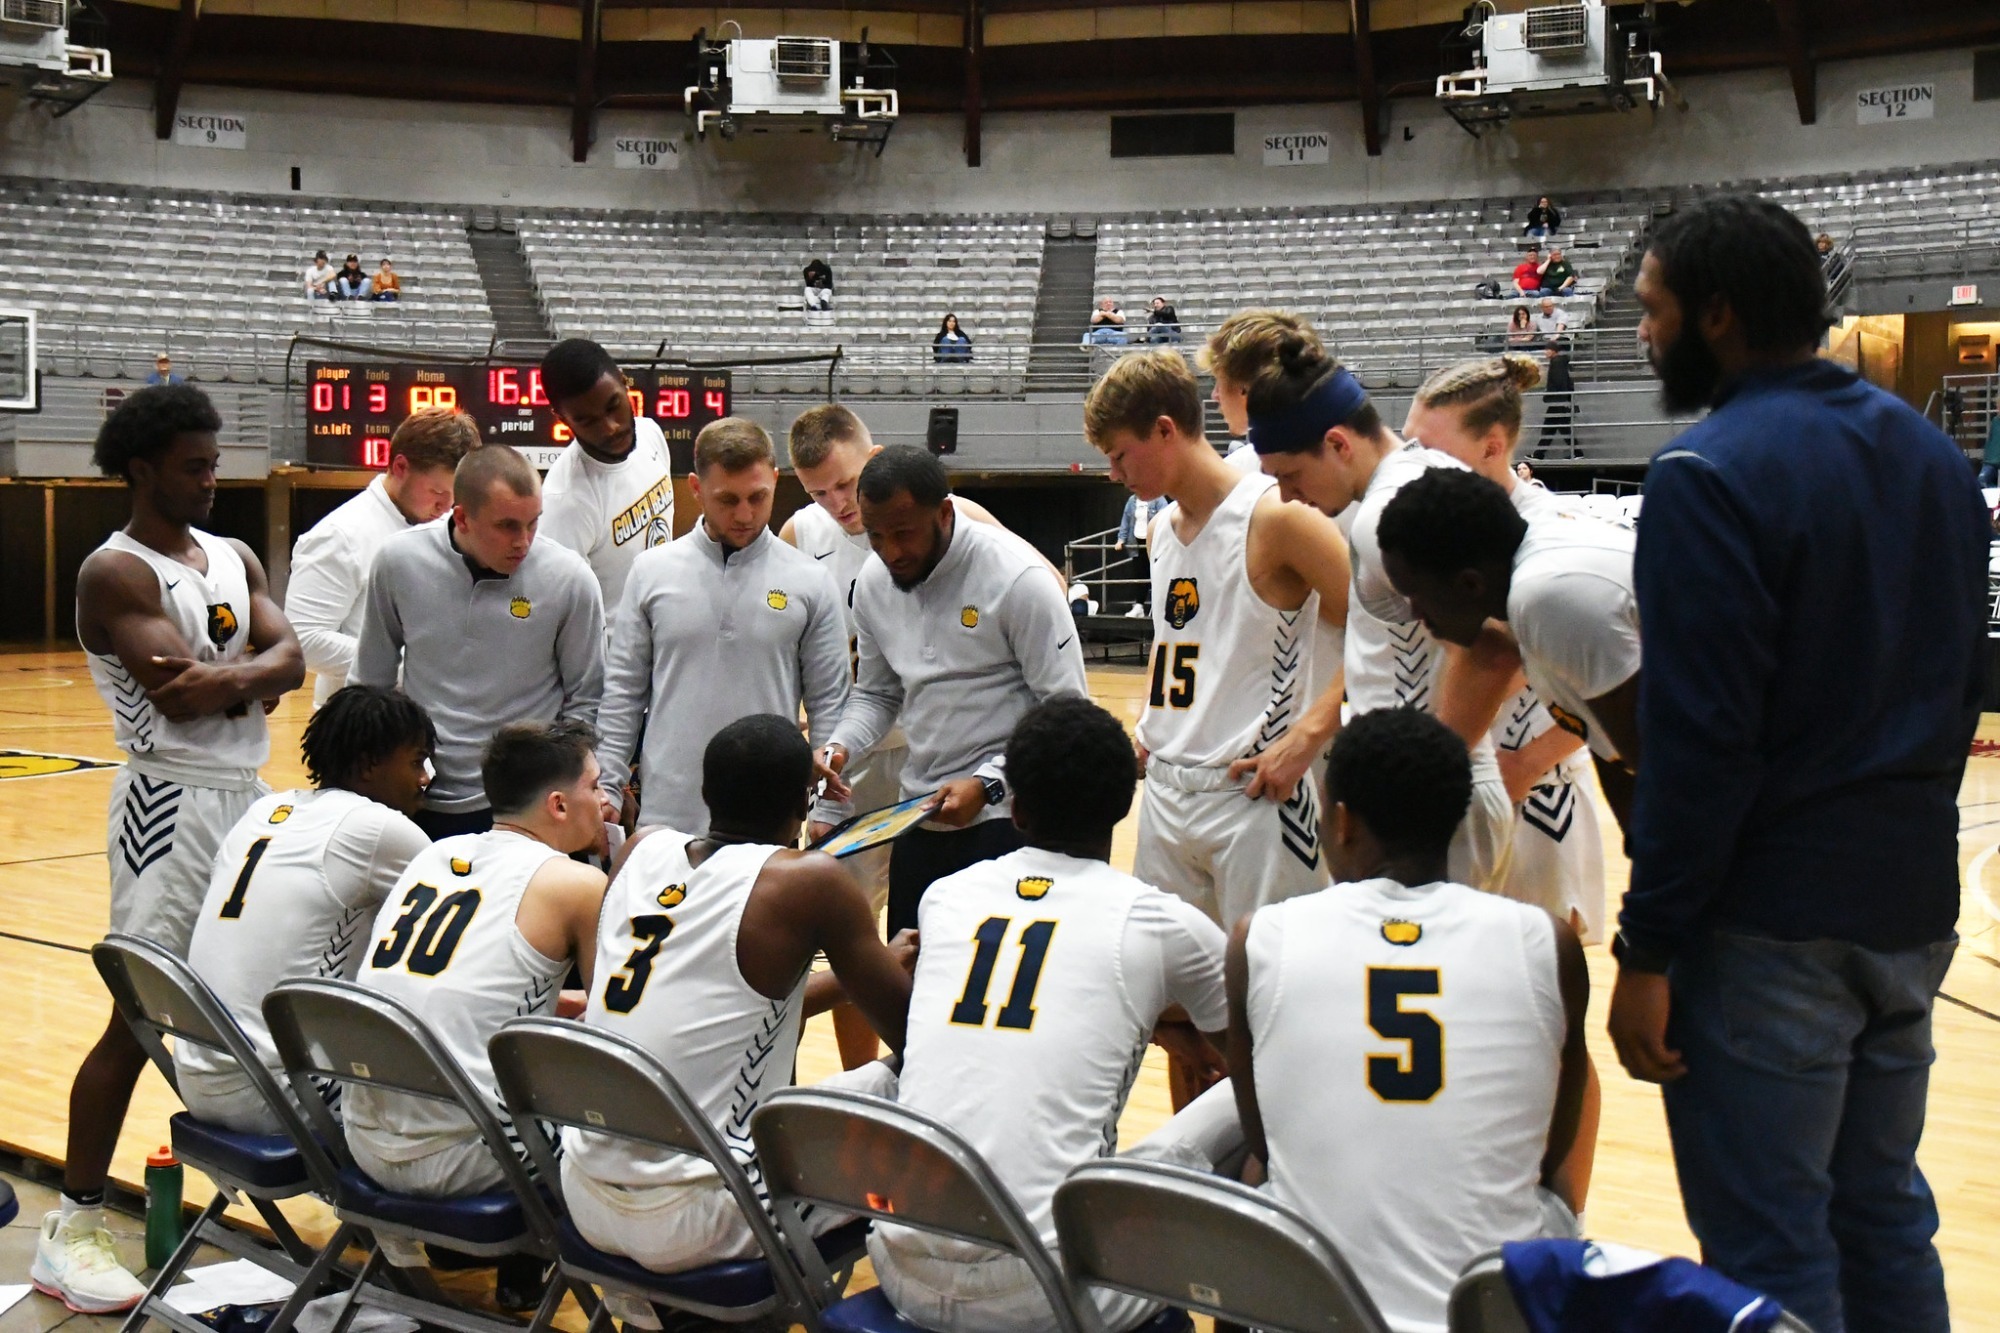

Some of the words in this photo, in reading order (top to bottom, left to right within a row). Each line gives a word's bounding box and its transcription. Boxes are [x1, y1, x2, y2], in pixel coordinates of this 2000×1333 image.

[1858, 86, 1932, 107] SECTION
[1885, 103, 1906, 117] 12
[179, 116, 244, 132] SECTION
[207, 130, 216, 143] 9
[1265, 135, 1328, 150] SECTION
[616, 140, 678, 154] SECTION
[1288, 149, 1304, 160] 11
[639, 153, 657, 165] 10
[1957, 286, 1972, 299] EXIT
[316, 367, 350, 380] player
[417, 370, 445, 382] Home
[659, 375, 689, 387] player
[704, 377, 725, 388] fouls
[369, 384, 386, 412] 3
[657, 390, 690, 417] 20
[705, 391, 723, 416] 4
[366, 424, 390, 433] team
[502, 420, 534, 432] period
[364, 439, 390, 466] 10
[1150, 642, 1200, 710] 15
[219, 836, 271, 920] 1
[371, 881, 483, 978] 30
[603, 913, 676, 1015] 3
[948, 914, 1060, 1033] 11
[1365, 964, 1446, 1105] 5
